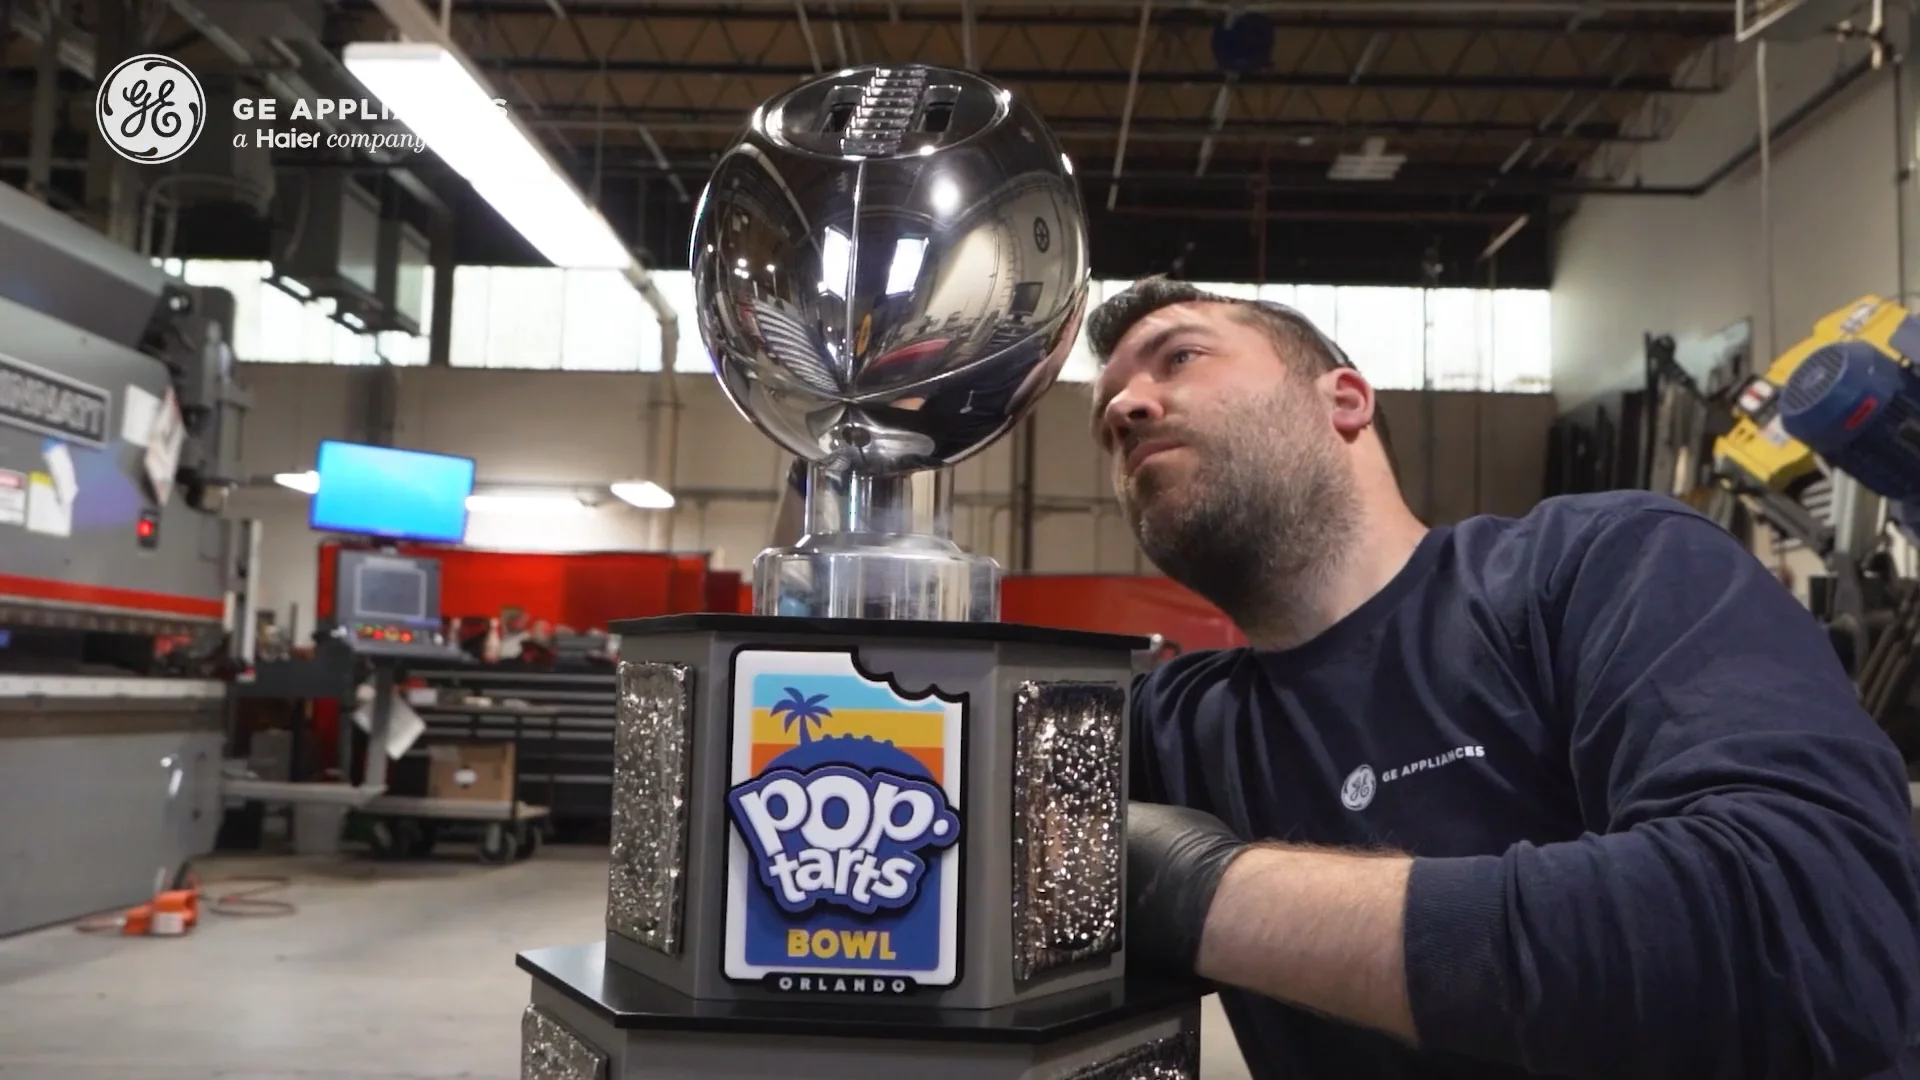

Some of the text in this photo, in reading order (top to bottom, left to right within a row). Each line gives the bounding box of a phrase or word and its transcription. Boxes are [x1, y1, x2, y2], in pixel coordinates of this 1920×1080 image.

[1382, 746, 1485, 783] GE APPLIANCES
[769, 848, 915, 904] tarts
[787, 928, 897, 960] BOWL
[779, 976, 906, 993] ORLANDO
